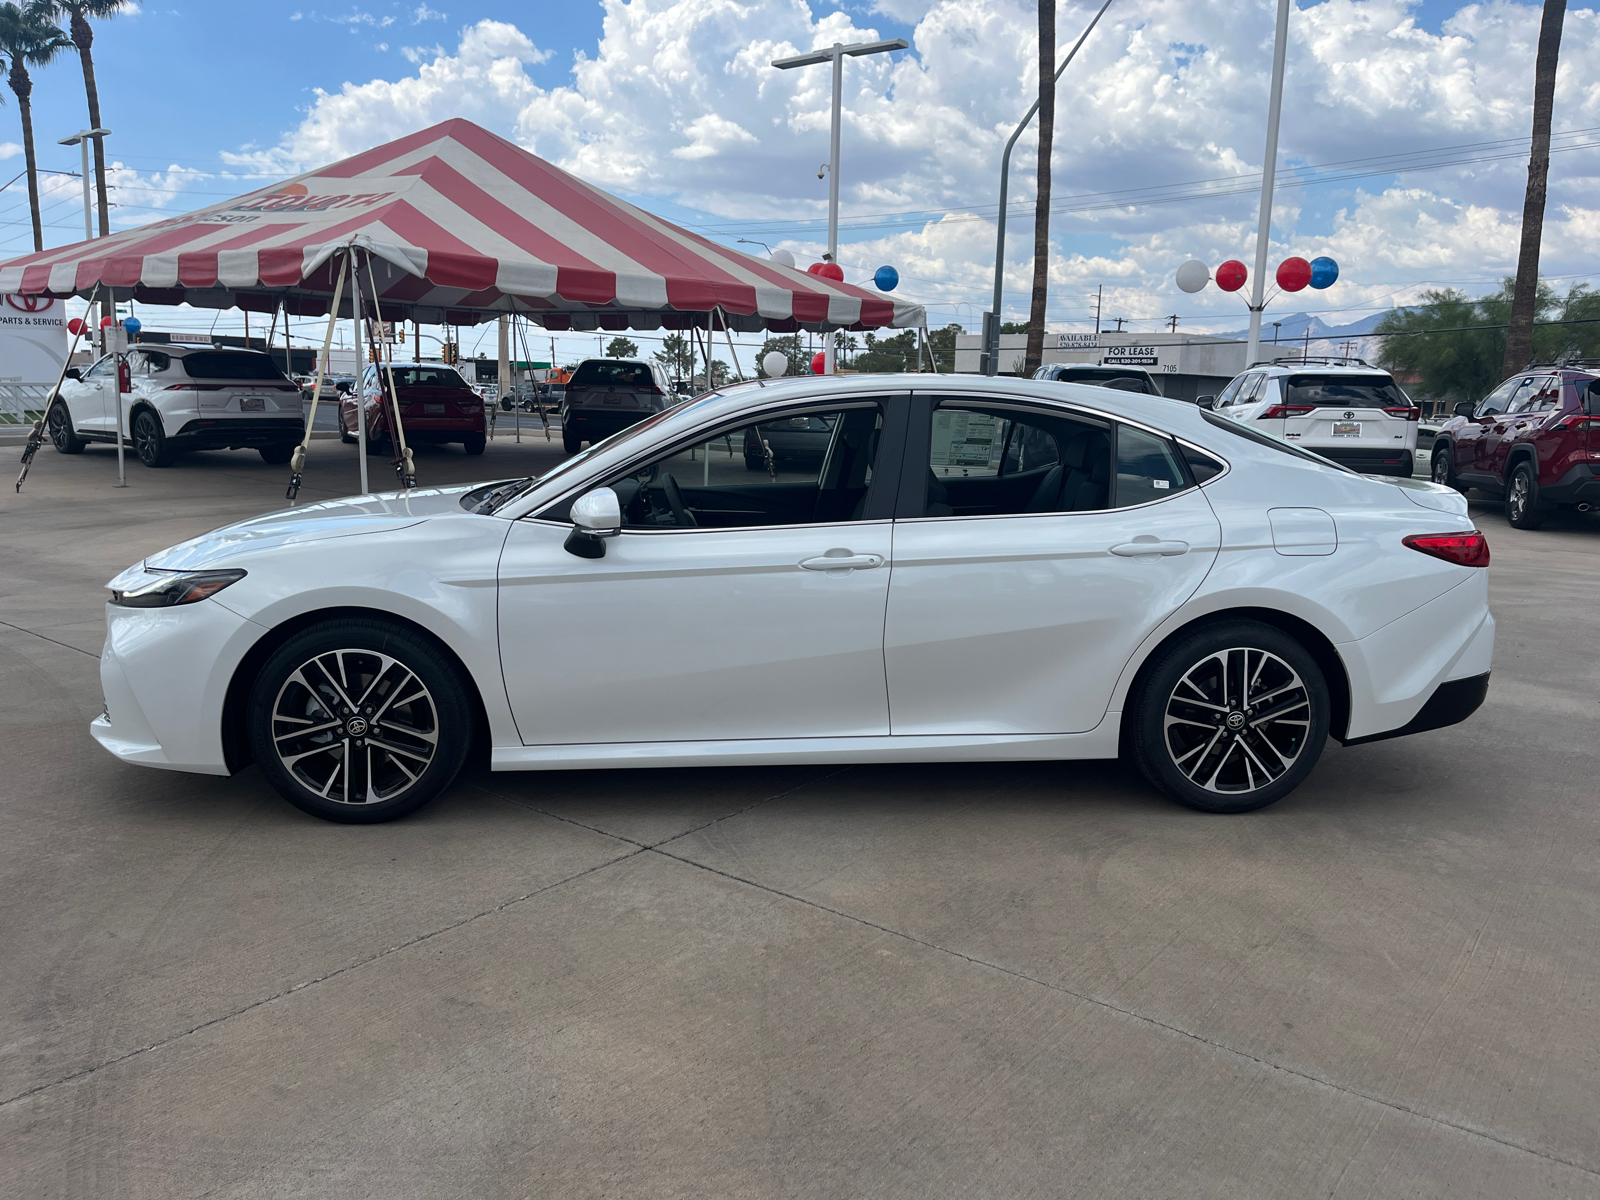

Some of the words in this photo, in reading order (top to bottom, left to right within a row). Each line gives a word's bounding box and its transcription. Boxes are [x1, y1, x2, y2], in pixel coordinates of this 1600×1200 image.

[243, 191, 397, 211] TOYOTA
[33, 318, 64, 326] SERVICE
[1108, 347, 1126, 356] FOR
[1129, 347, 1155, 356] LEASE
[1163, 364, 1177, 372] 7105
